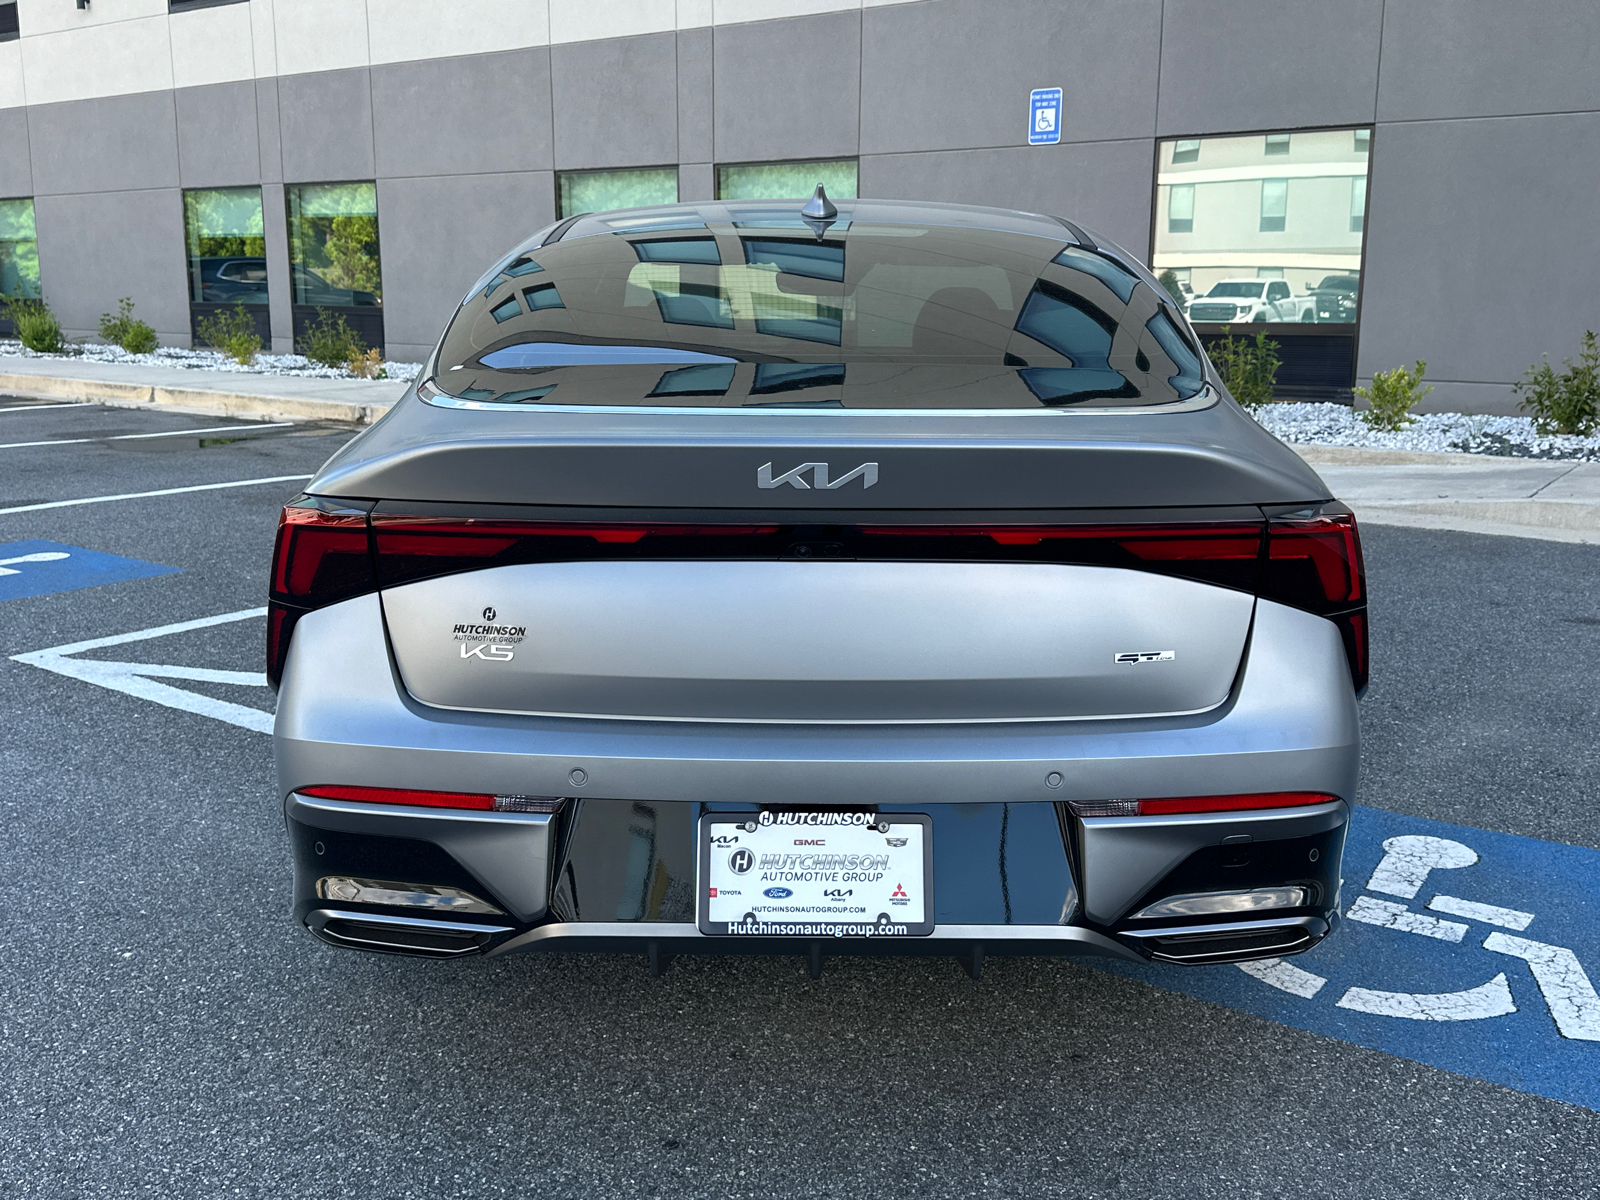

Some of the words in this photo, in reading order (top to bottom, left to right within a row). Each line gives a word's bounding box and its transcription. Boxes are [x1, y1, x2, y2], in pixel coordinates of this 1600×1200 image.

[757, 461, 878, 490] KIA
[453, 624, 526, 636] HUTCHINSON
[460, 643, 514, 662] K5
[776, 812, 876, 826] HUTCHINSON
[758, 854, 889, 870] HUTCHINSON
[760, 872, 838, 882] AUTOMOTIVE
[842, 872, 883, 882] GROUP
[768, 888, 789, 898] Ford
[823, 889, 853, 897] KIA
[752, 906, 866, 914] HUTCHINSONAUTOGROUP.COM
[728, 921, 907, 937] Hutchinsonautogroup.com
